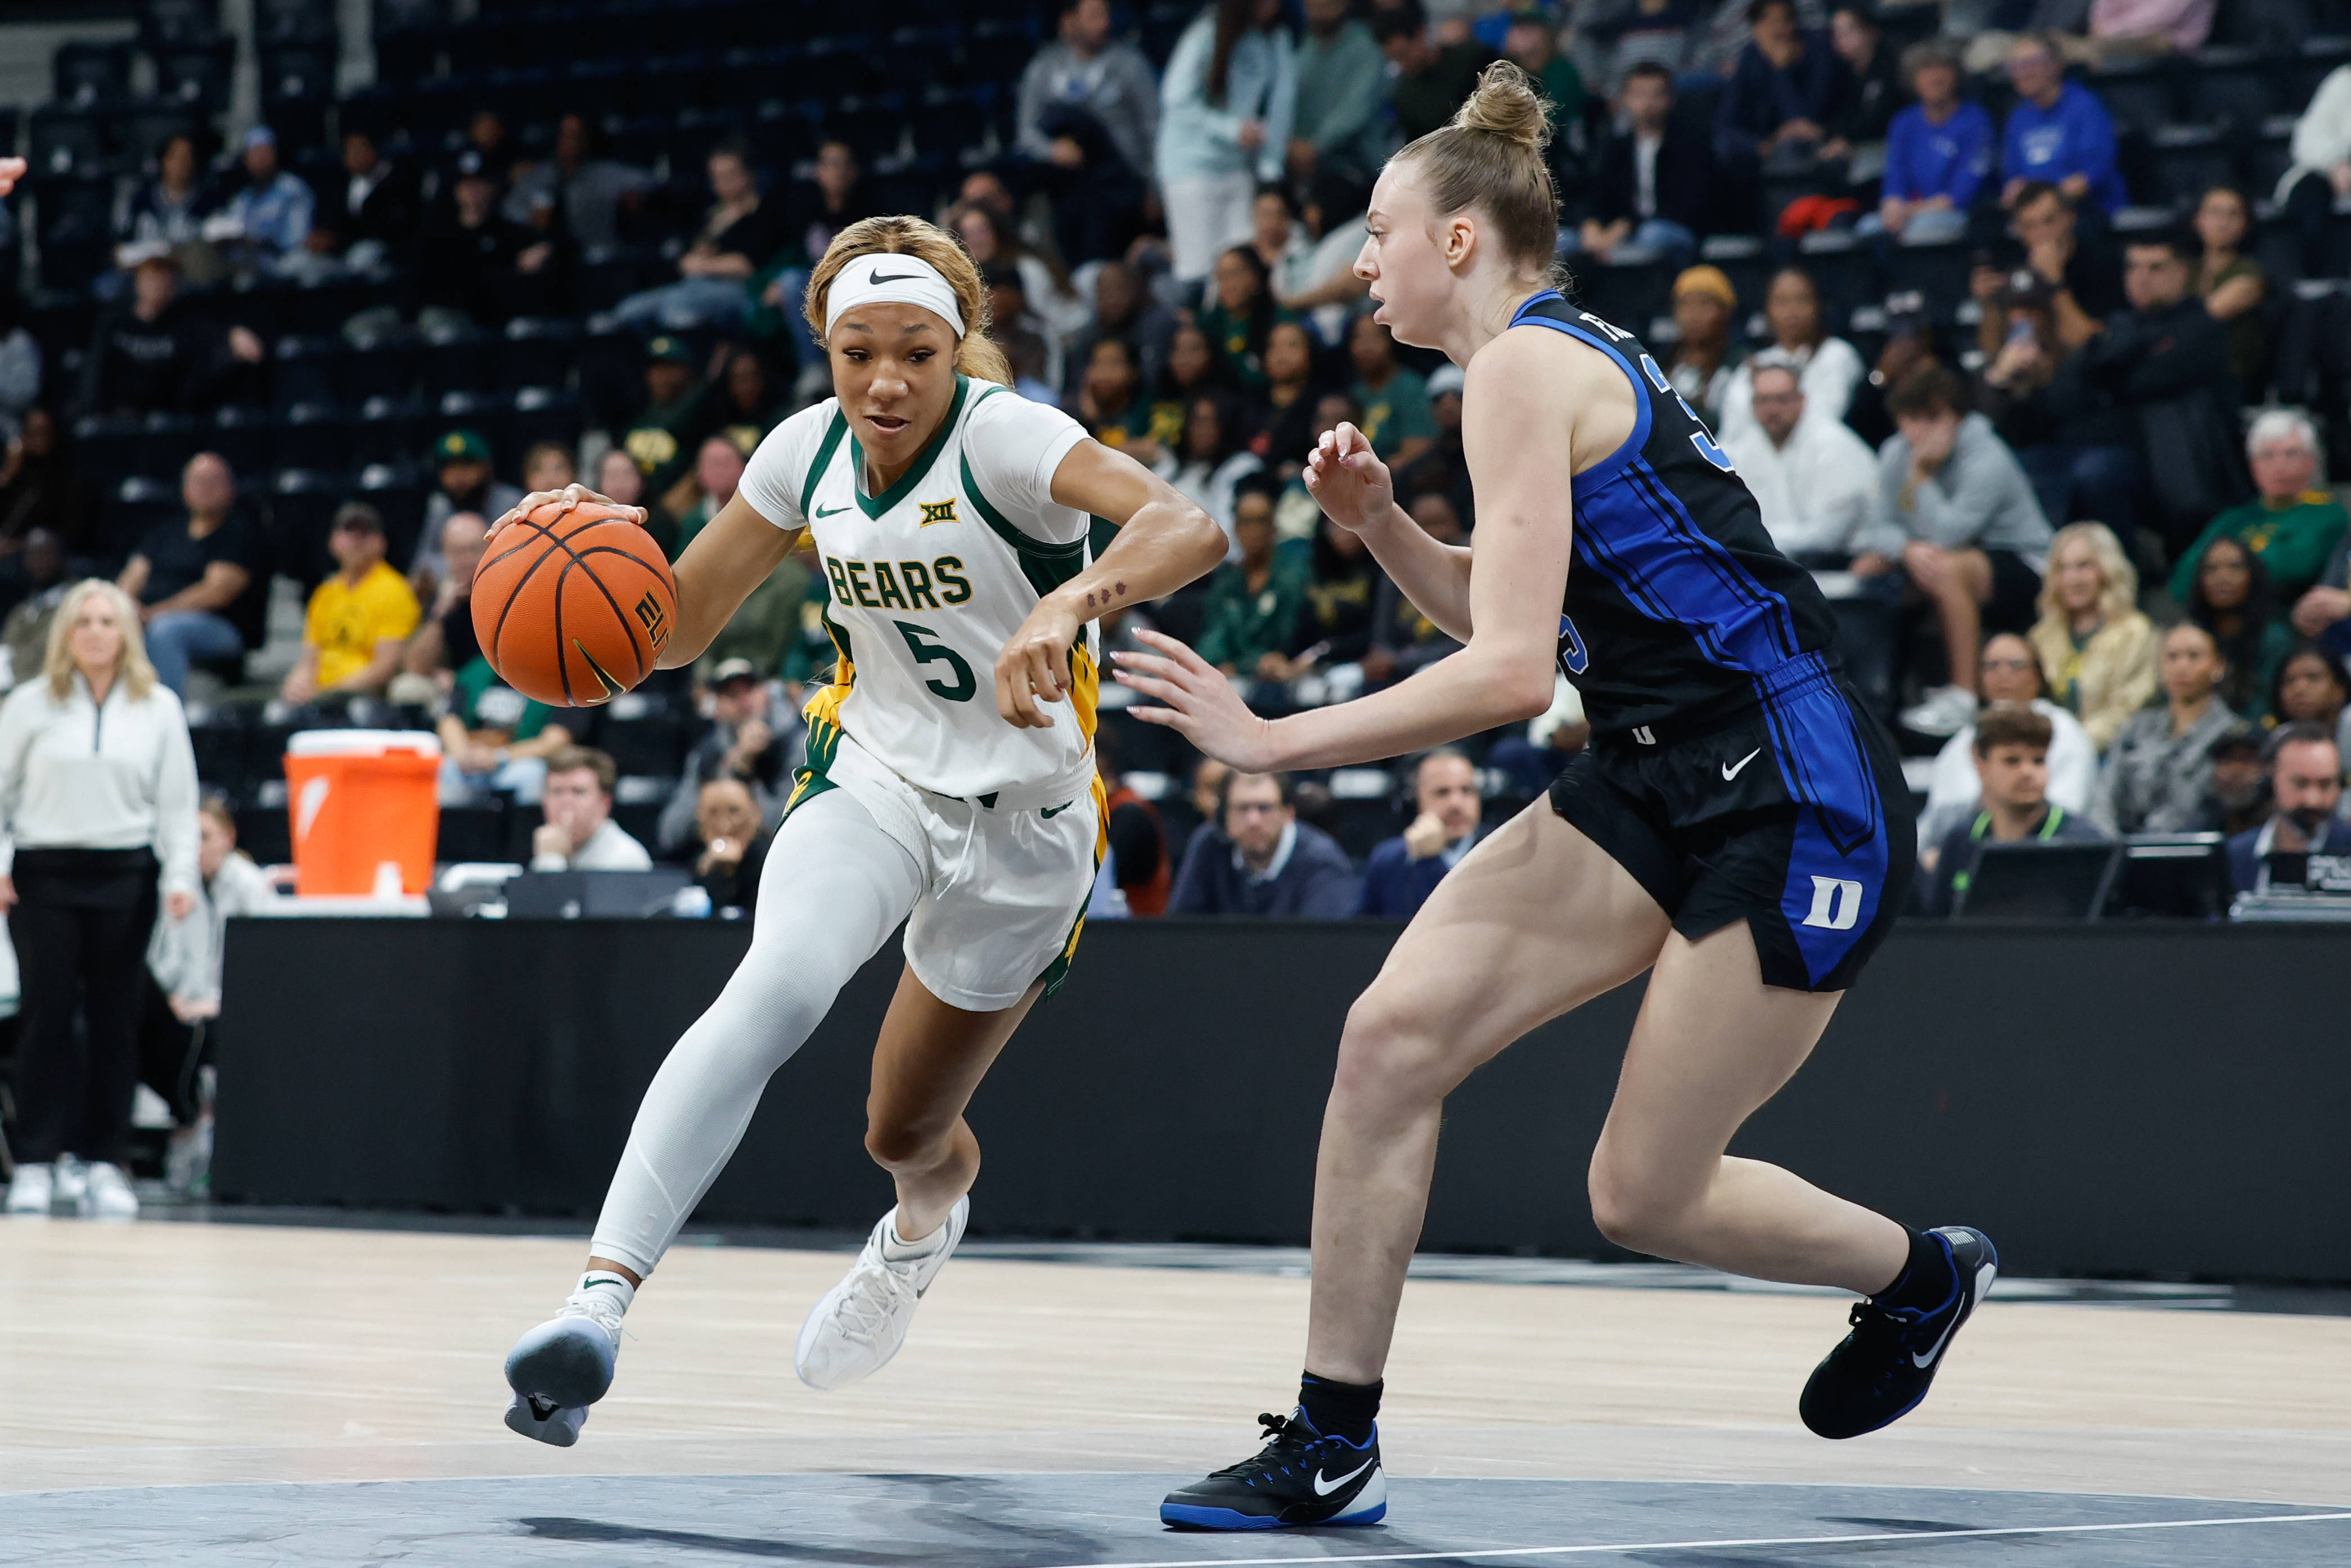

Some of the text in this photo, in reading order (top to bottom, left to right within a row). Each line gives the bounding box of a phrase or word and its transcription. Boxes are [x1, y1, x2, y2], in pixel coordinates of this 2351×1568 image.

[919, 498, 960, 527] XII
[826, 555, 974, 610] BEARS
[892, 620, 976, 702] 5
[1801, 875, 1863, 930] D
